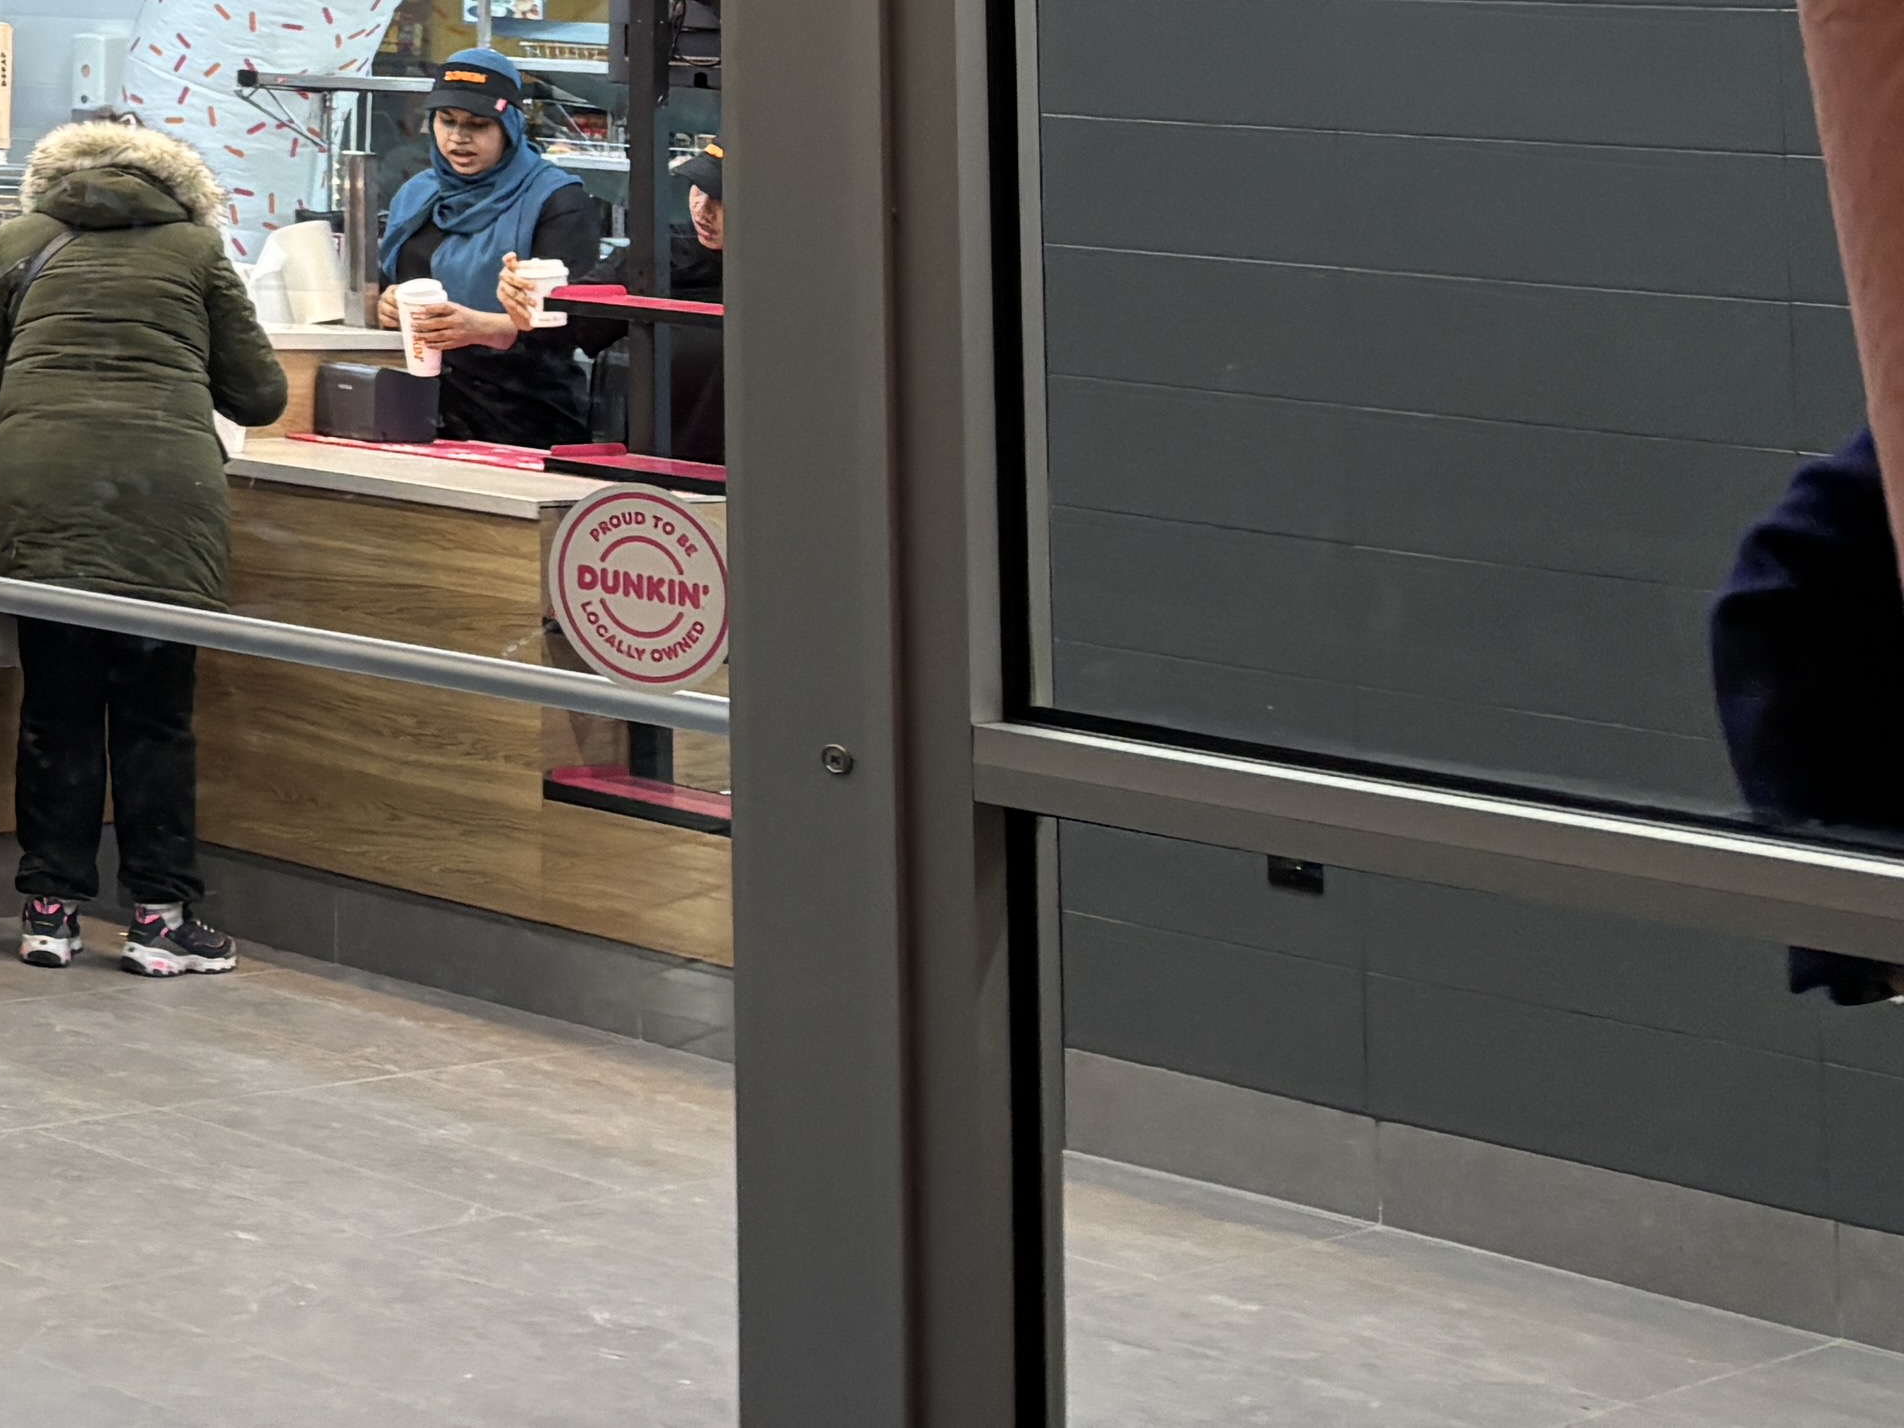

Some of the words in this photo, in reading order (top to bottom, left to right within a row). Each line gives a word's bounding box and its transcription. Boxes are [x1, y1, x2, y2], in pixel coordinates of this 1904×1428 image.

[588, 511, 646, 543] PROUD
[651, 515, 675, 535] TO
[677, 533, 699, 558] BE
[577, 564, 710, 610] DUNKIN'
[580, 600, 646, 662] LOCALLY
[650, 620, 706, 663] OWNED
